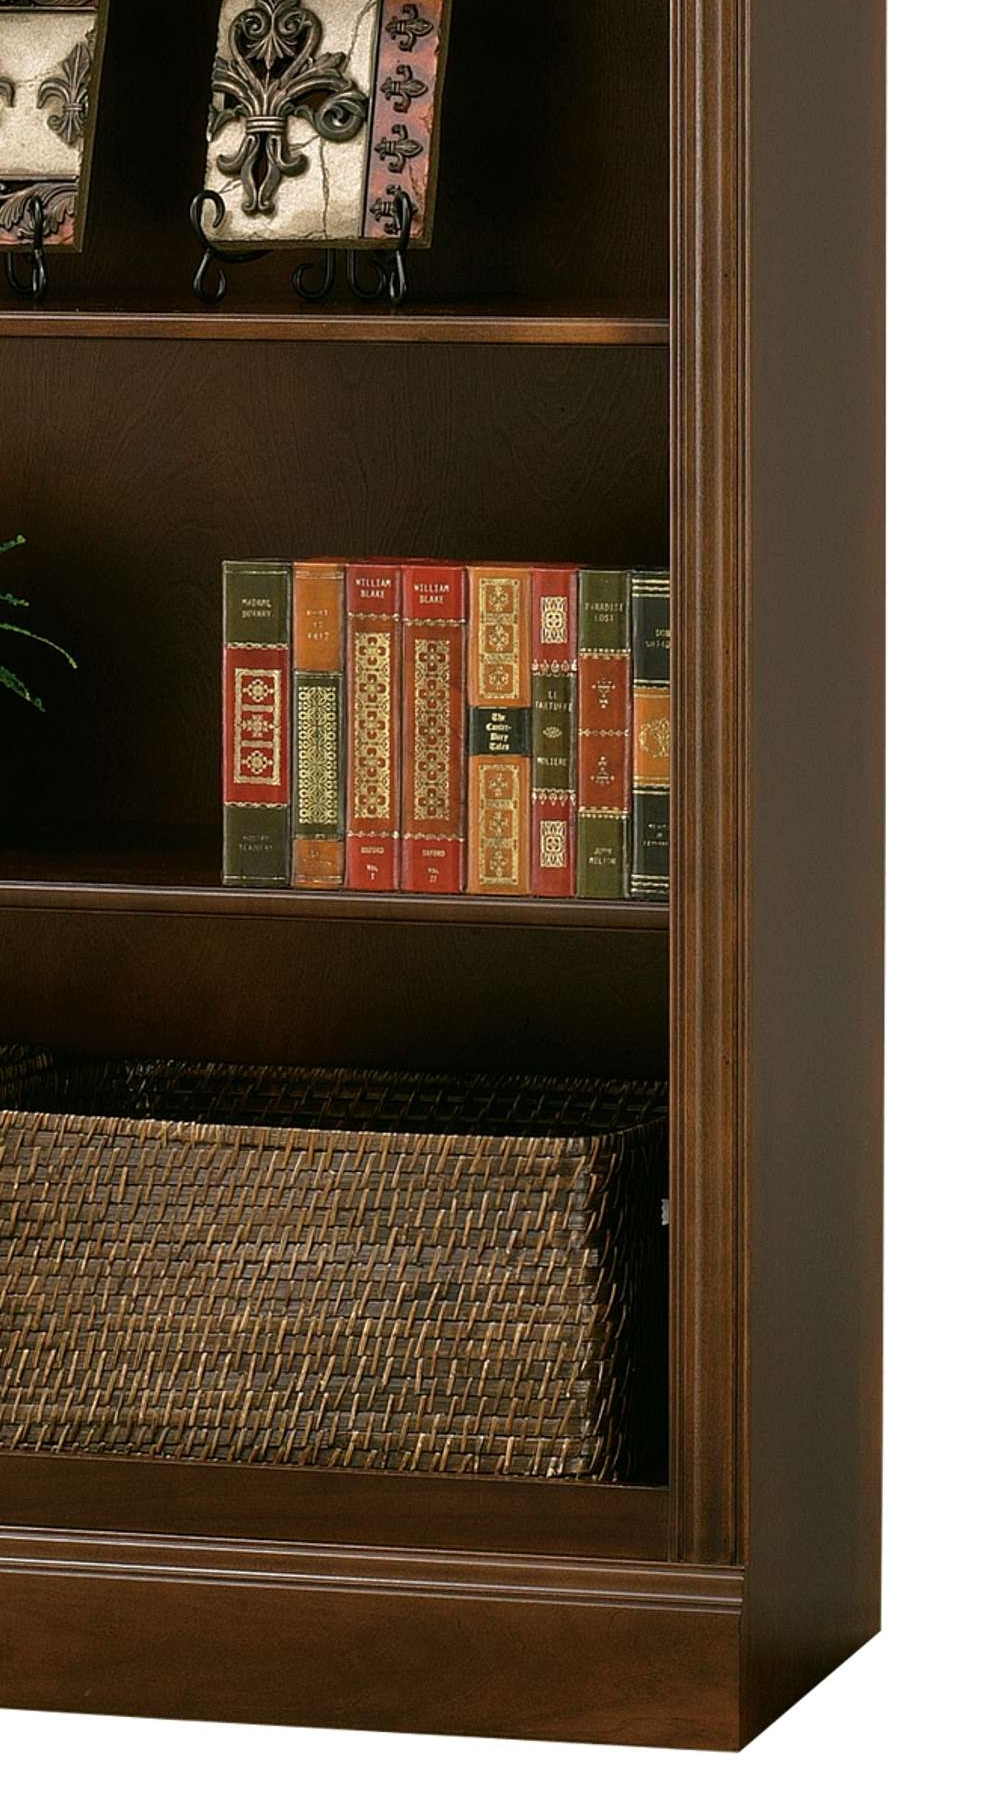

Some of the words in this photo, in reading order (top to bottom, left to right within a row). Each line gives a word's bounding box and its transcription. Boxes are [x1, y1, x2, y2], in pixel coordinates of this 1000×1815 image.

[355, 578, 391, 588] WILLIAM
[413, 584, 450, 593] WILLIAM
[360, 590, 385, 598] BLAKE
[419, 595, 444, 604] BLAKE
[584, 602, 624, 612] PARADISE
[594, 613, 614, 622] LOST
[535, 701, 573, 713] TARTUFFE
[491, 712, 506, 722] The
[489, 742, 510, 751] Tales
[361, 846, 385, 854] OXFORD
[422, 849, 446, 857] OXFORD
[370, 872, 376, 880] I
